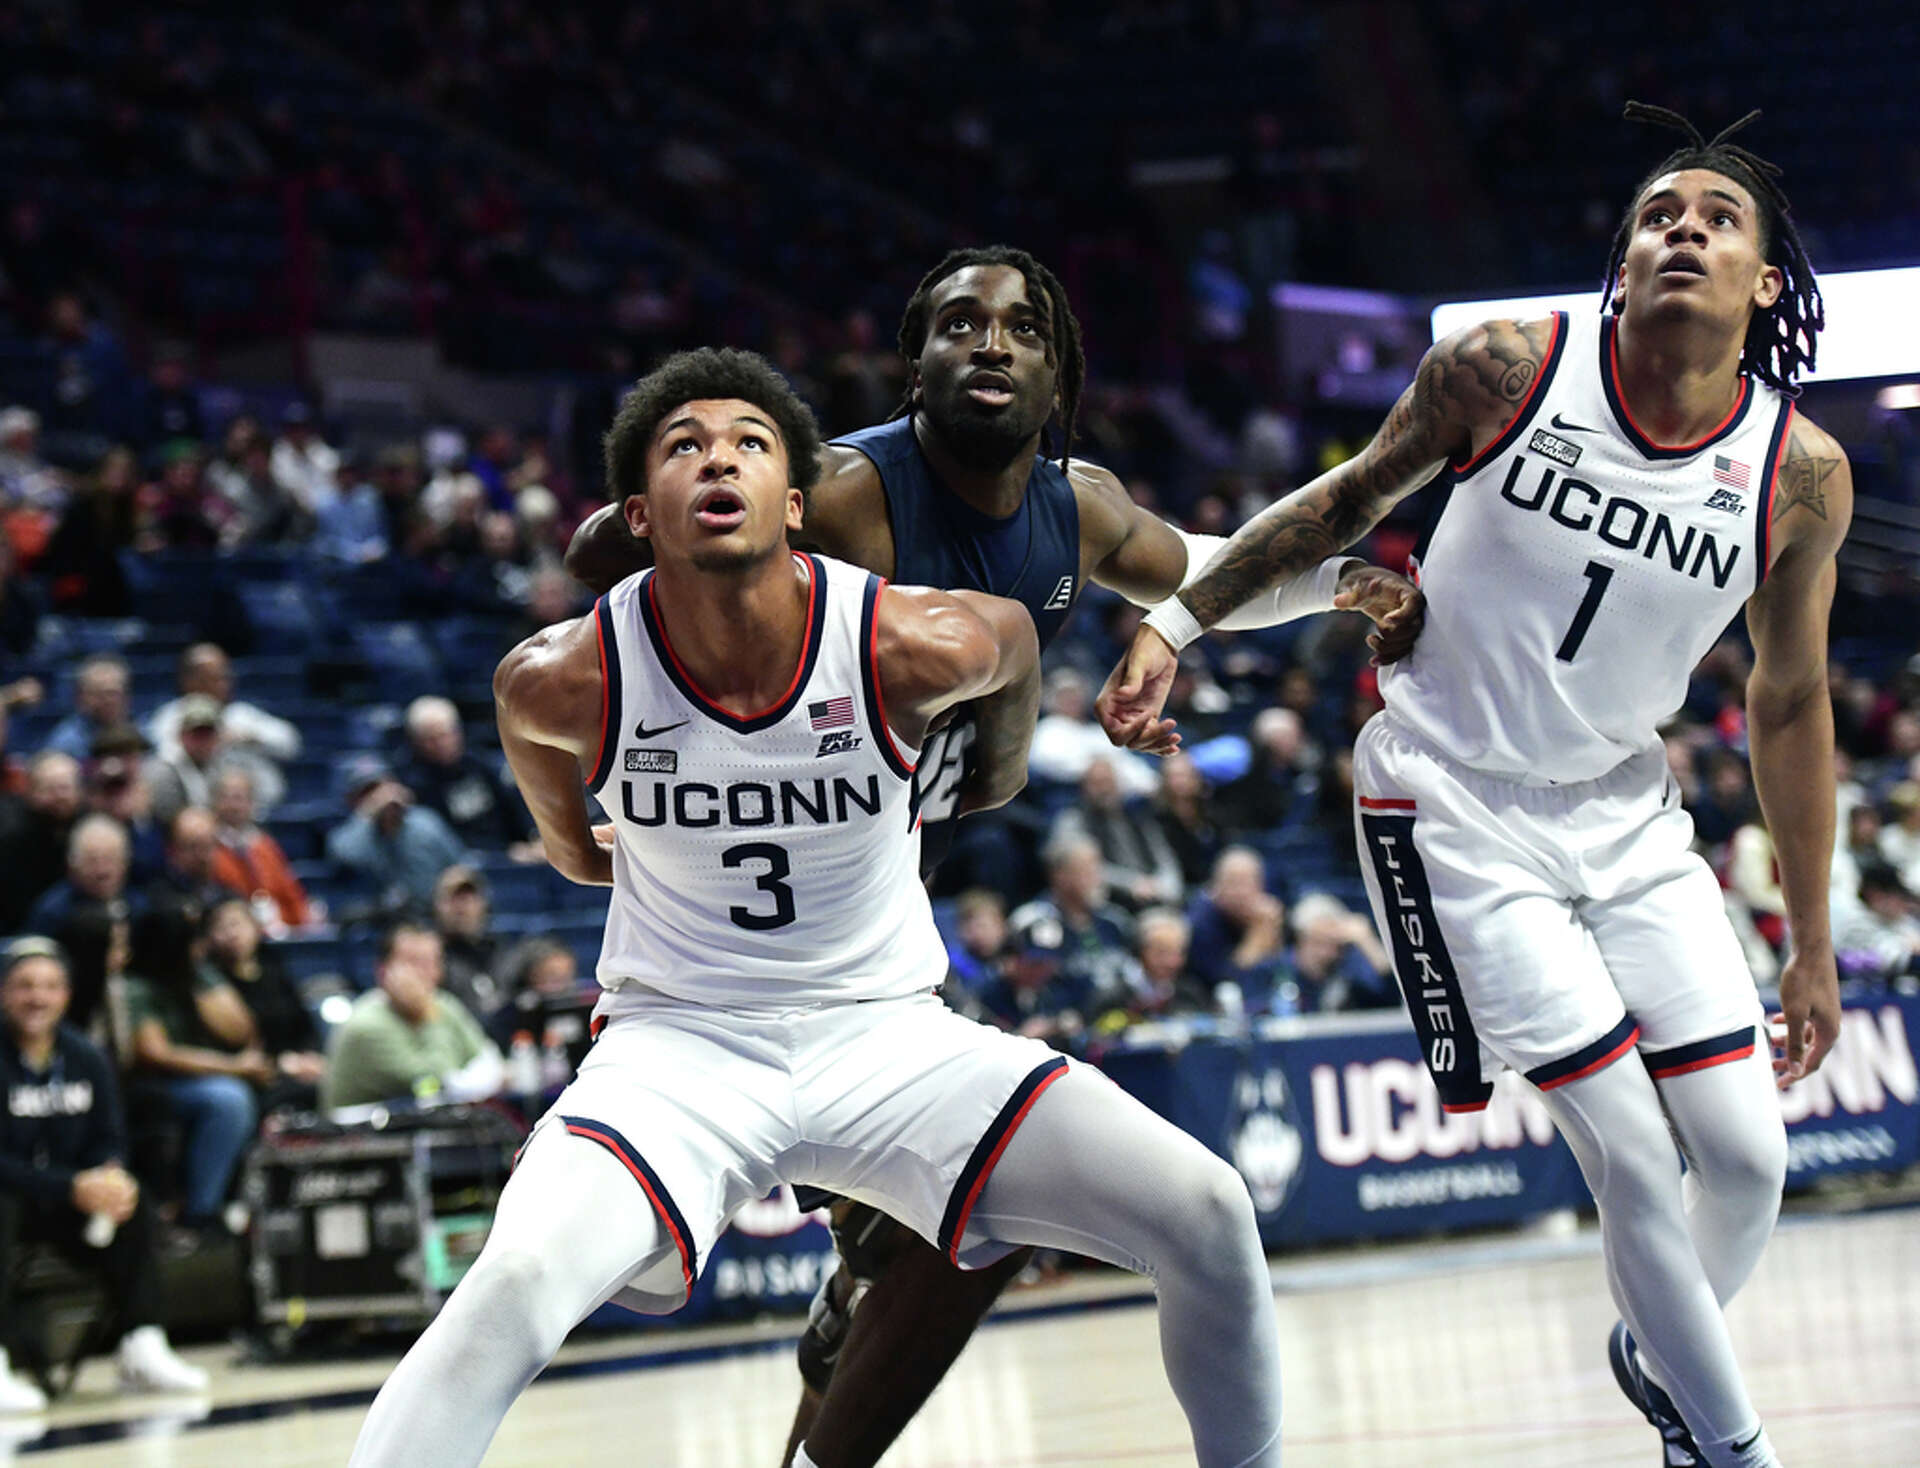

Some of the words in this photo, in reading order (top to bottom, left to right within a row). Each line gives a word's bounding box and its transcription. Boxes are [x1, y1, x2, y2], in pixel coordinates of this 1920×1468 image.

[1501, 455, 1741, 589] UCONN
[1555, 560, 1615, 662] 1
[621, 774, 882, 828] UCONN
[721, 842, 796, 931] 3
